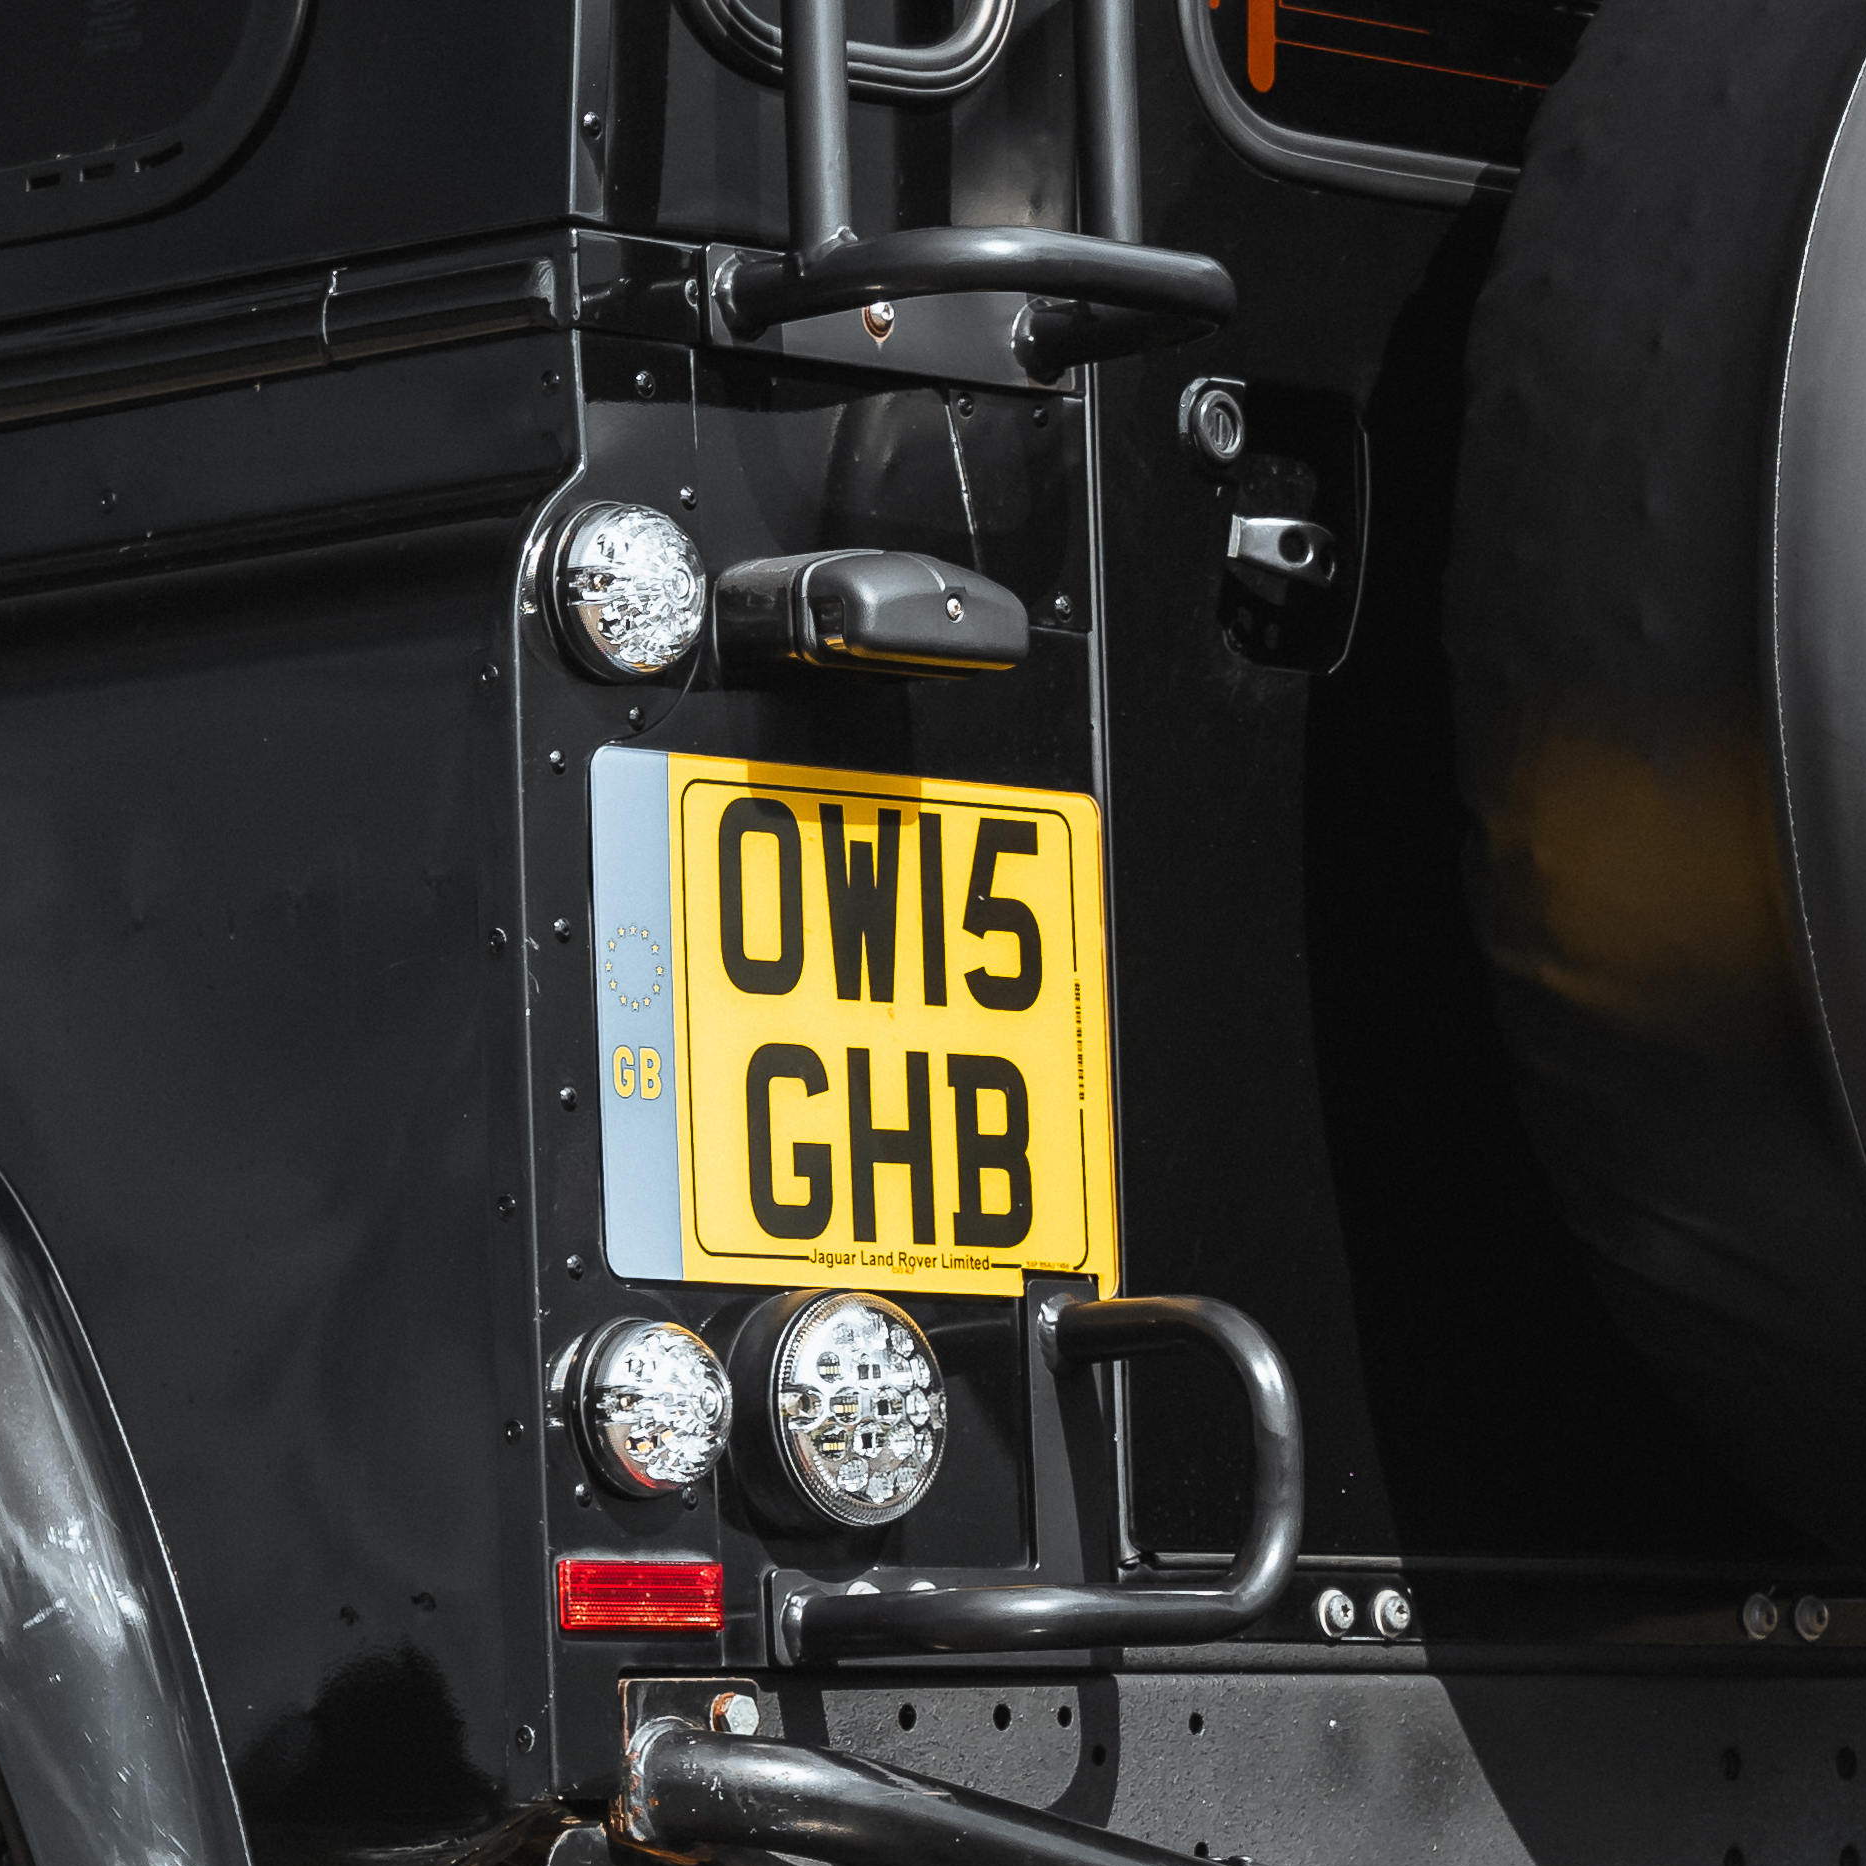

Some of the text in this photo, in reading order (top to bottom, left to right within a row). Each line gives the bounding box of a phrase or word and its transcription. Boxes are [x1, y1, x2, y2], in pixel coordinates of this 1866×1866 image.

[718, 797, 1043, 1012] OW15
[612, 1045, 663, 1100] GB
[745, 1042, 1034, 1249] GHB
[810, 1248, 990, 1271] Jaguar Land Rover Limited
